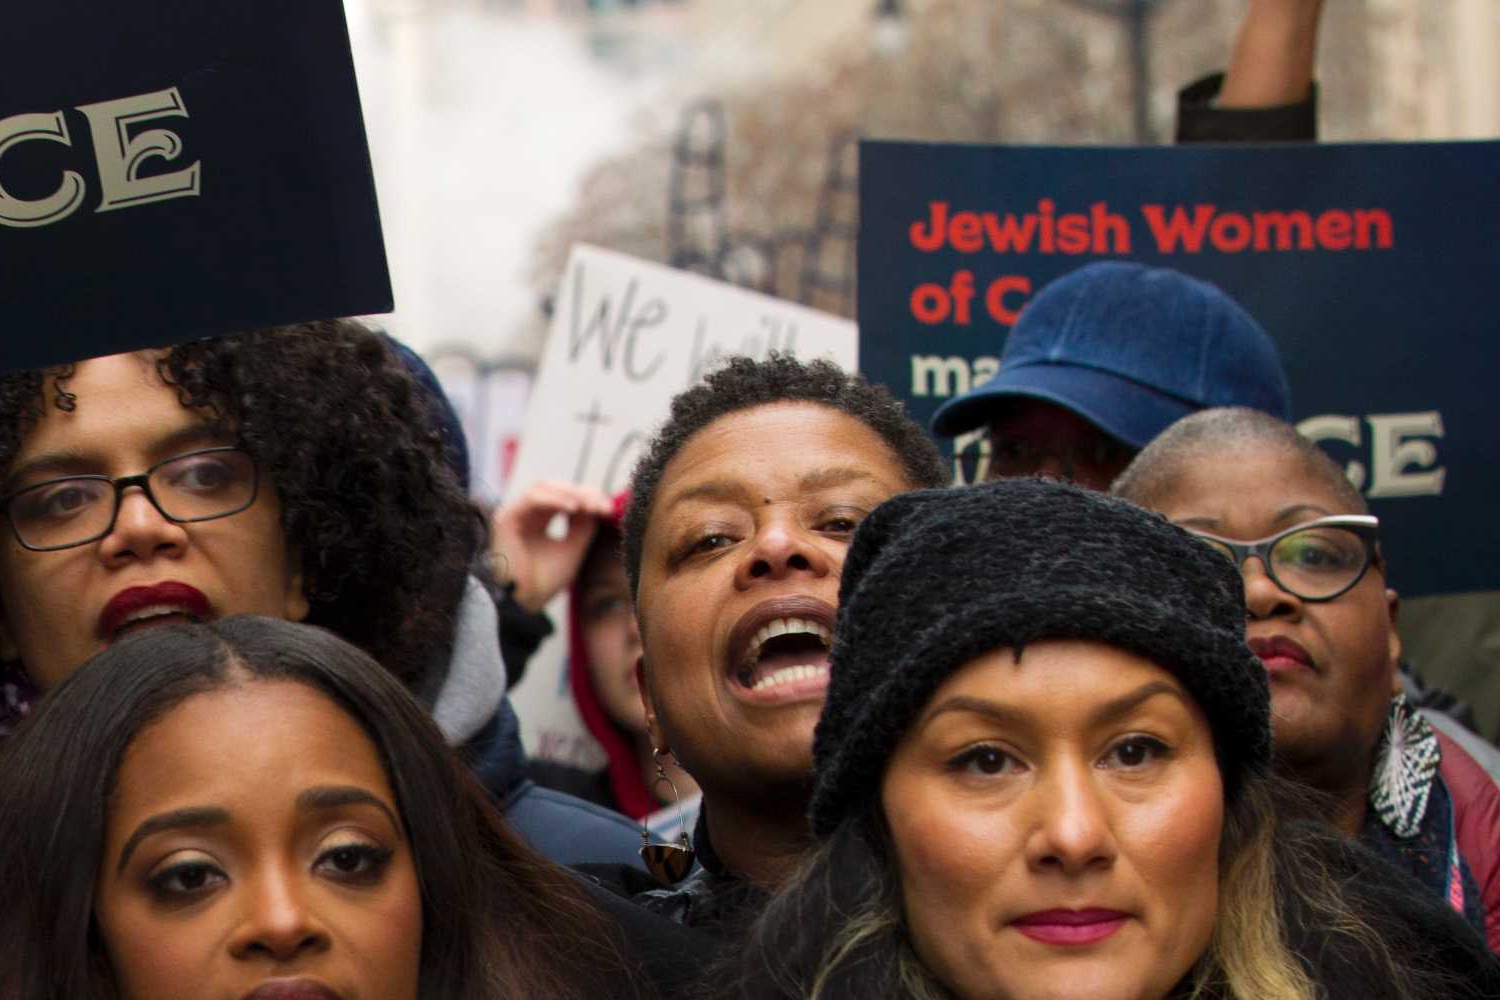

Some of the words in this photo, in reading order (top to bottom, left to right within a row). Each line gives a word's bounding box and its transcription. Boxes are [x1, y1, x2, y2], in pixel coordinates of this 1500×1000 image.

[909, 199, 1132, 255] Jewish
[1140, 202, 1395, 254] Women
[566, 258, 670, 385] We
[909, 269, 974, 325] of
